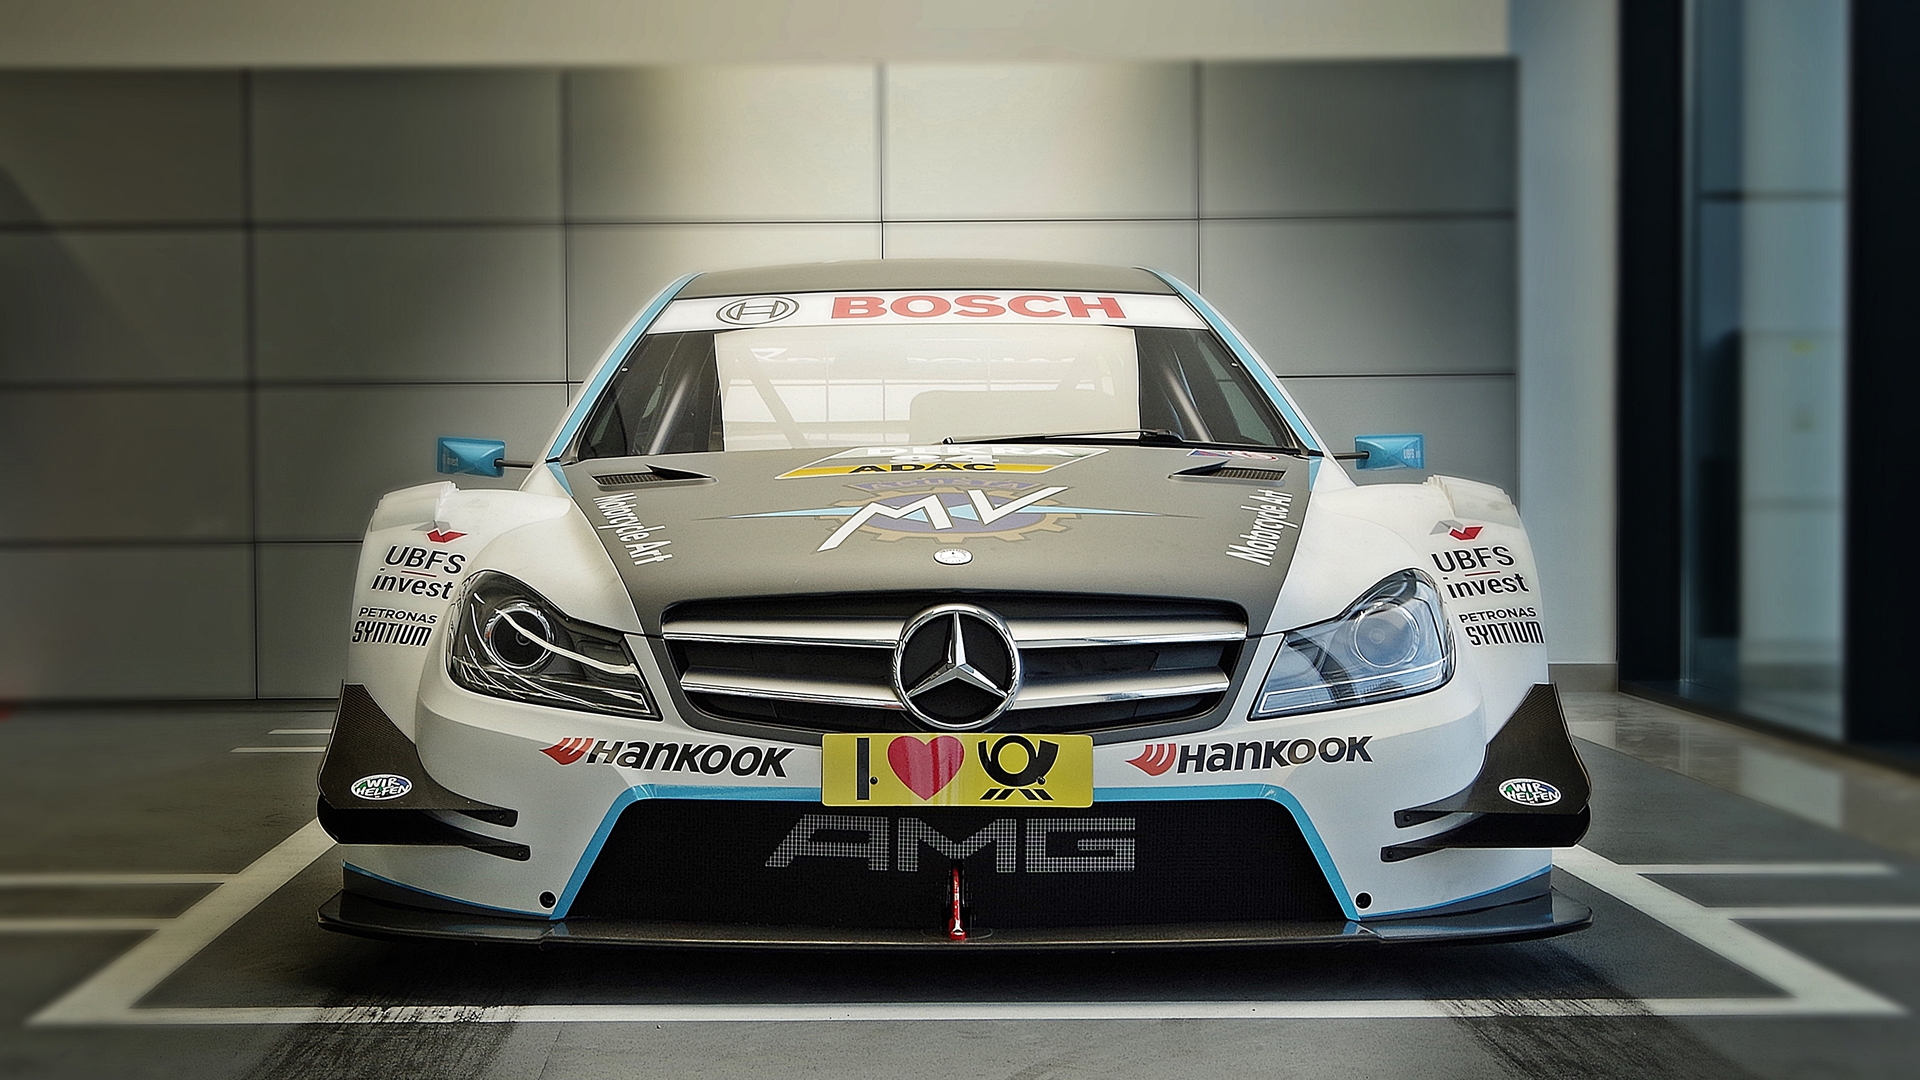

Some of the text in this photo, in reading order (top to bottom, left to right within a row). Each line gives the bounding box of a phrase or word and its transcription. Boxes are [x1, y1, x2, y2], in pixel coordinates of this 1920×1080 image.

[831, 295, 1125, 320] BOSCH
[849, 463, 997, 473] ADAC
[1248, 489, 1293, 507] Art
[593, 493, 673, 566] Motorcycle Art
[817, 486, 1070, 552] MV
[1226, 505, 1299, 566] Motorcycle
[385, 545, 466, 574] UBFS
[1431, 546, 1514, 573] UBFS
[371, 568, 453, 599] invest
[1442, 574, 1529, 599] invest
[358, 607, 437, 624] PETRONAS
[1459, 607, 1537, 624] PETRONAS
[352, 621, 433, 647] SYNTIUM
[1466, 622, 1545, 646] SYNTIUM
[857, 737, 870, 801] I
[355, 784, 410, 797] HELFEN
[366, 777, 401, 788] WIR
[1510, 781, 1547, 793] WIR
[1505, 790, 1558, 803] HELFEN
[765, 813, 1137, 873] AMG
